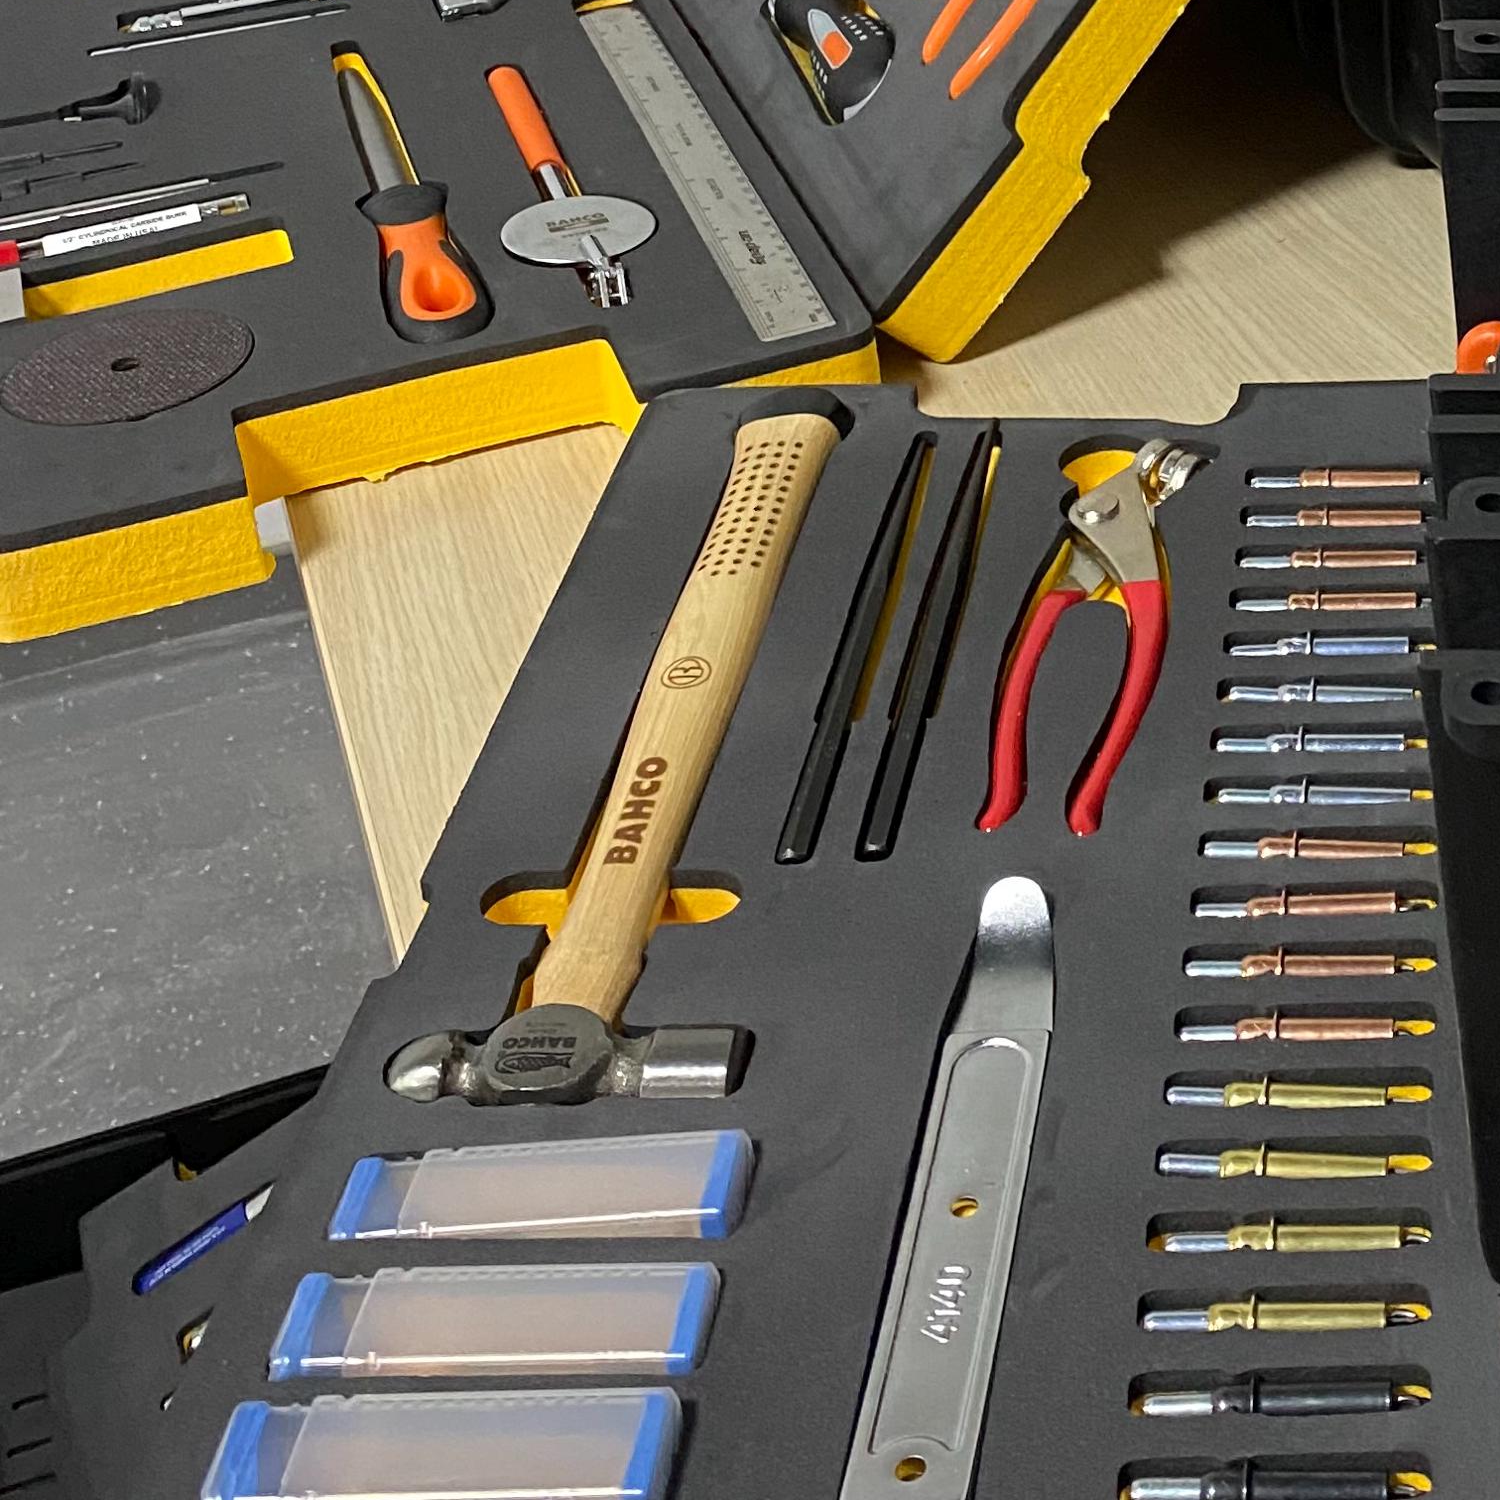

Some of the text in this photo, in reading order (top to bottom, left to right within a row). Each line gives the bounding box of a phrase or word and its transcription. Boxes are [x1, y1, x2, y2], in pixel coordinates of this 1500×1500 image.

[545, 212, 606, 228] BAHCO
[602, 756, 668, 865] BAHCO
[502, 1035, 578, 1050] BAHCO
